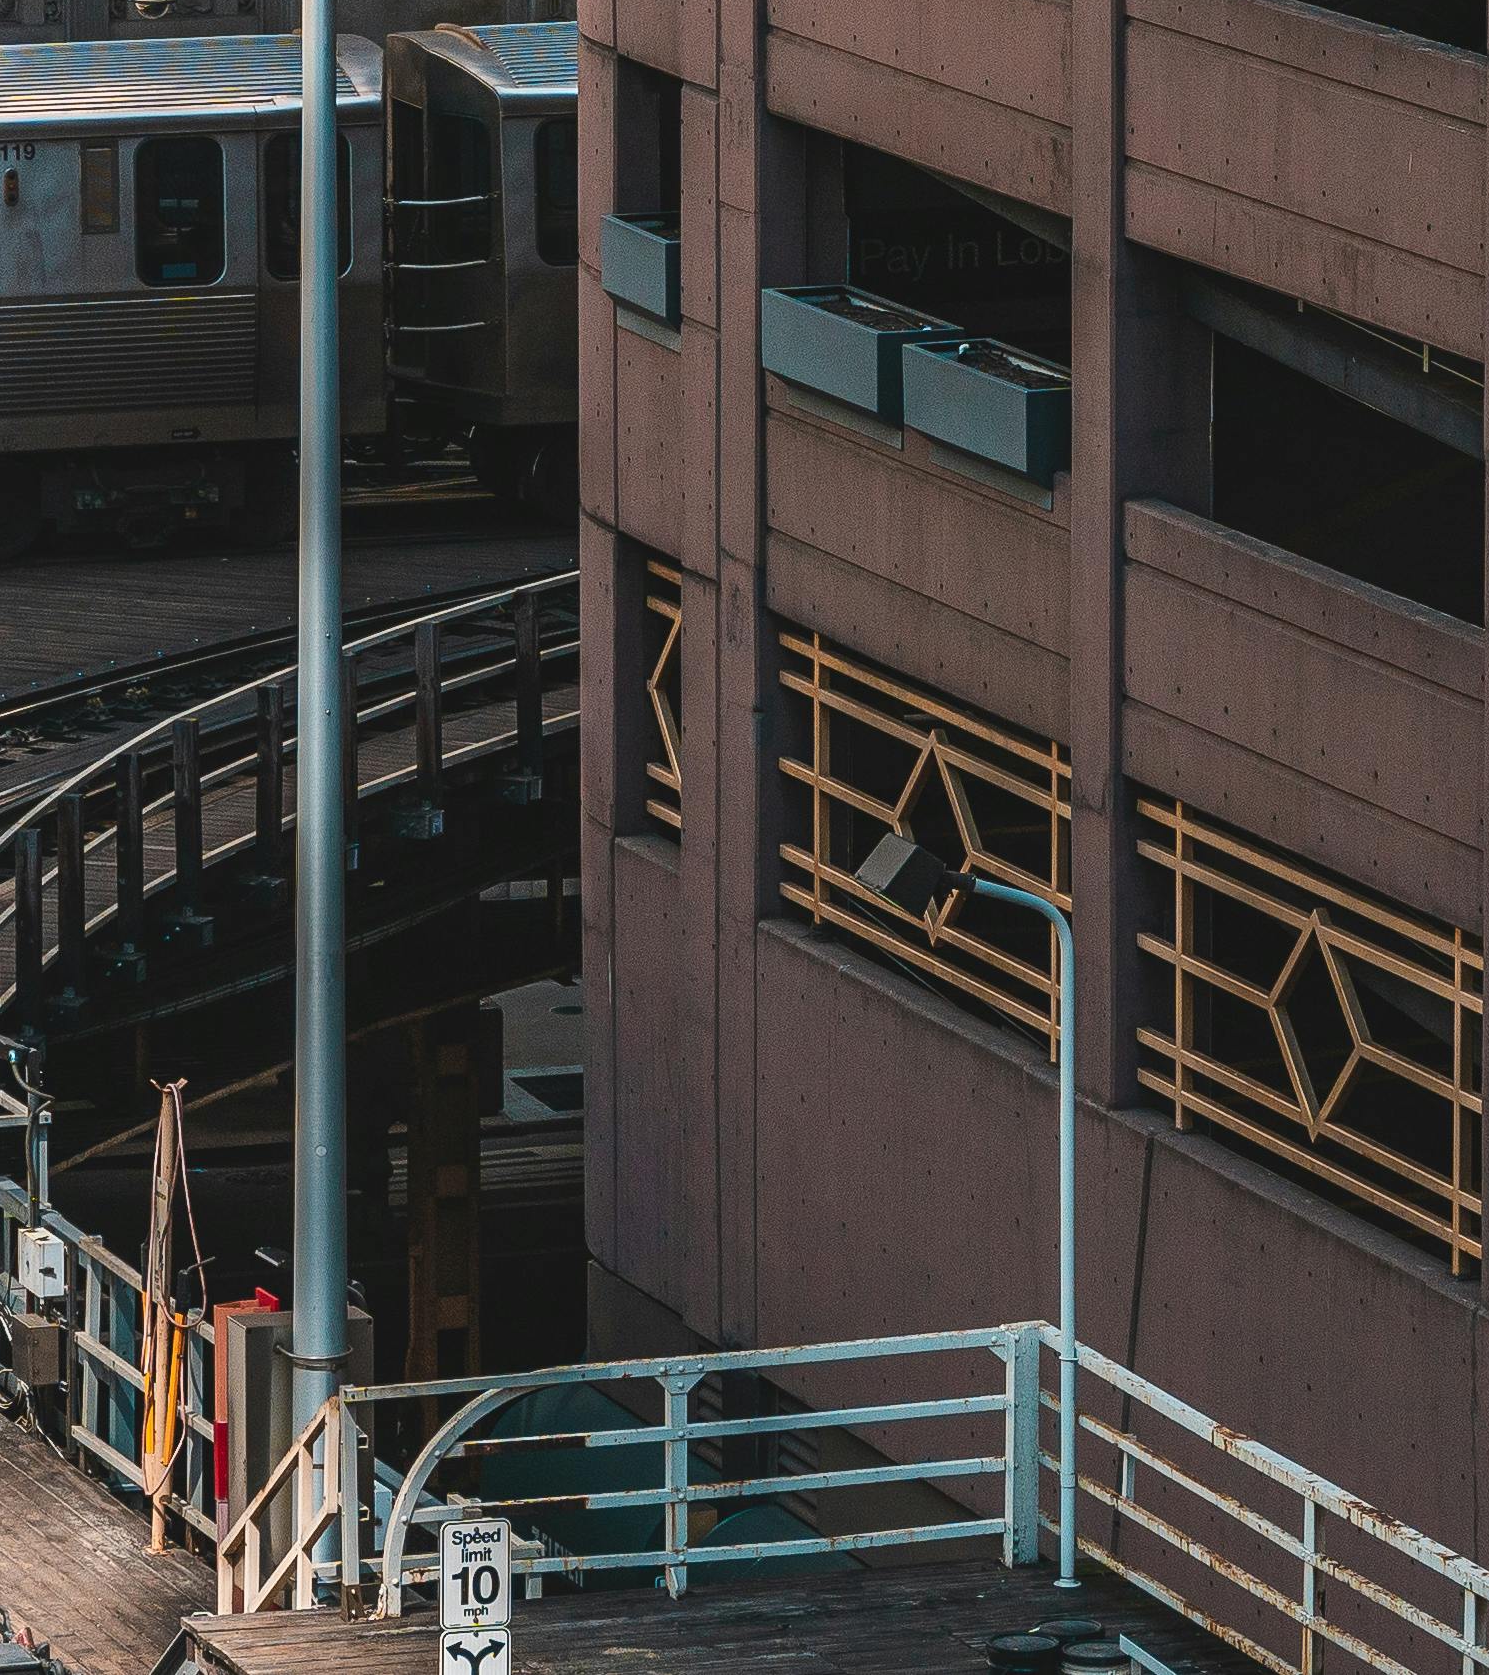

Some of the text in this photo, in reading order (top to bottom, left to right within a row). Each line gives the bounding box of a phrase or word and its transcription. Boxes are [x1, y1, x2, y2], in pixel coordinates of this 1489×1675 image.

[859, 237, 932, 283] Pay
[946, 231, 979, 269] In
[451, 1527, 502, 1548] Speed
[461, 1547, 493, 1564] limit
[451, 1565, 501, 1606] 10
[463, 1605, 489, 1618] mph
